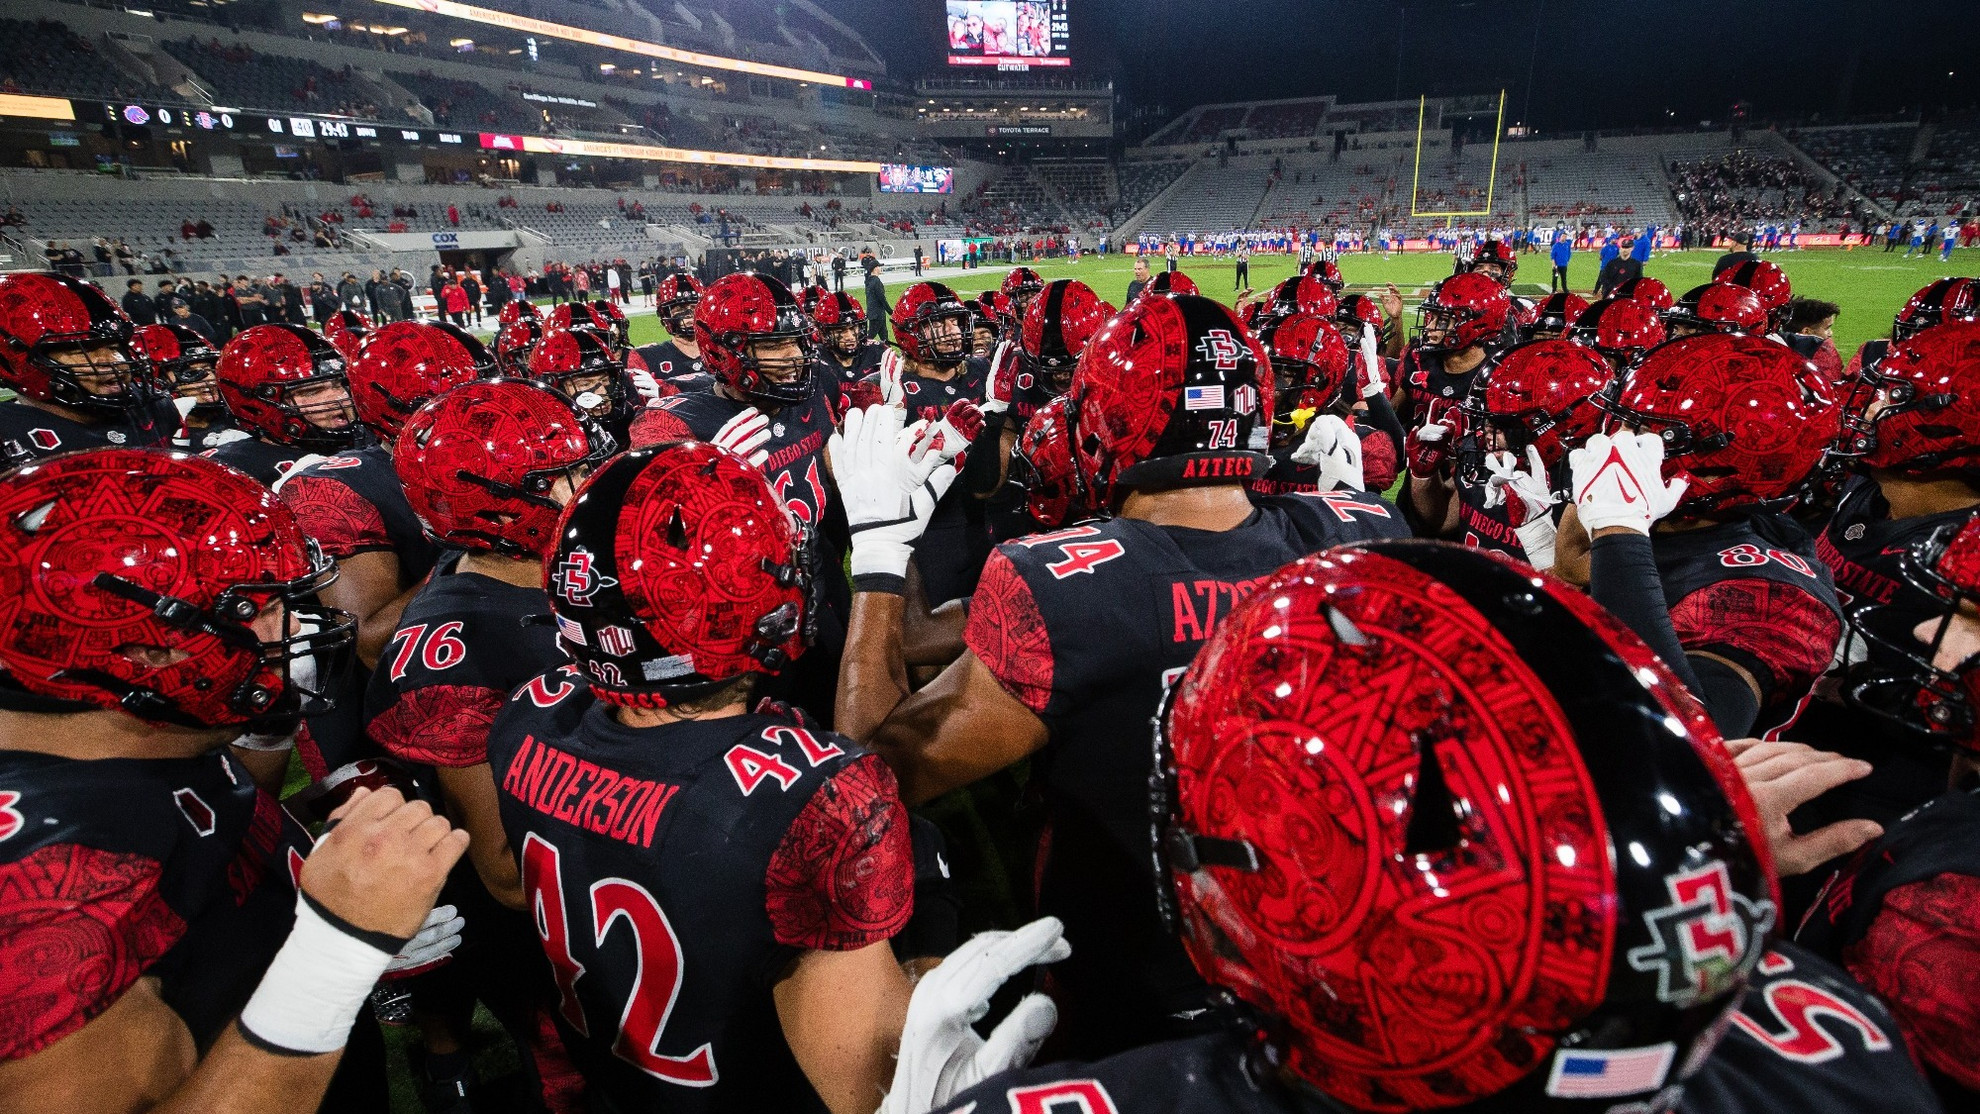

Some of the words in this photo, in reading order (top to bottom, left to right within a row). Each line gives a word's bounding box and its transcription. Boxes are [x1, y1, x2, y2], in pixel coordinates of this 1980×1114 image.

[158, 108, 171, 124] 0
[221, 113, 234, 129] 0
[319, 121, 349, 138] 29:43
[432, 233, 458, 243] COX
[1208, 419, 1238, 449] 74
[768, 443, 801, 472] DIEGO
[1183, 456, 1253, 478] AZTECS
[1470, 509, 1504, 540] DIEGO
[1717, 543, 1816, 578] 80
[1835, 561, 1901, 605] STATE
[391, 621, 466, 683] 76
[723, 724, 845, 797] 42
[503, 734, 681, 849] ANDERSON
[522, 831, 720, 1088] 42
